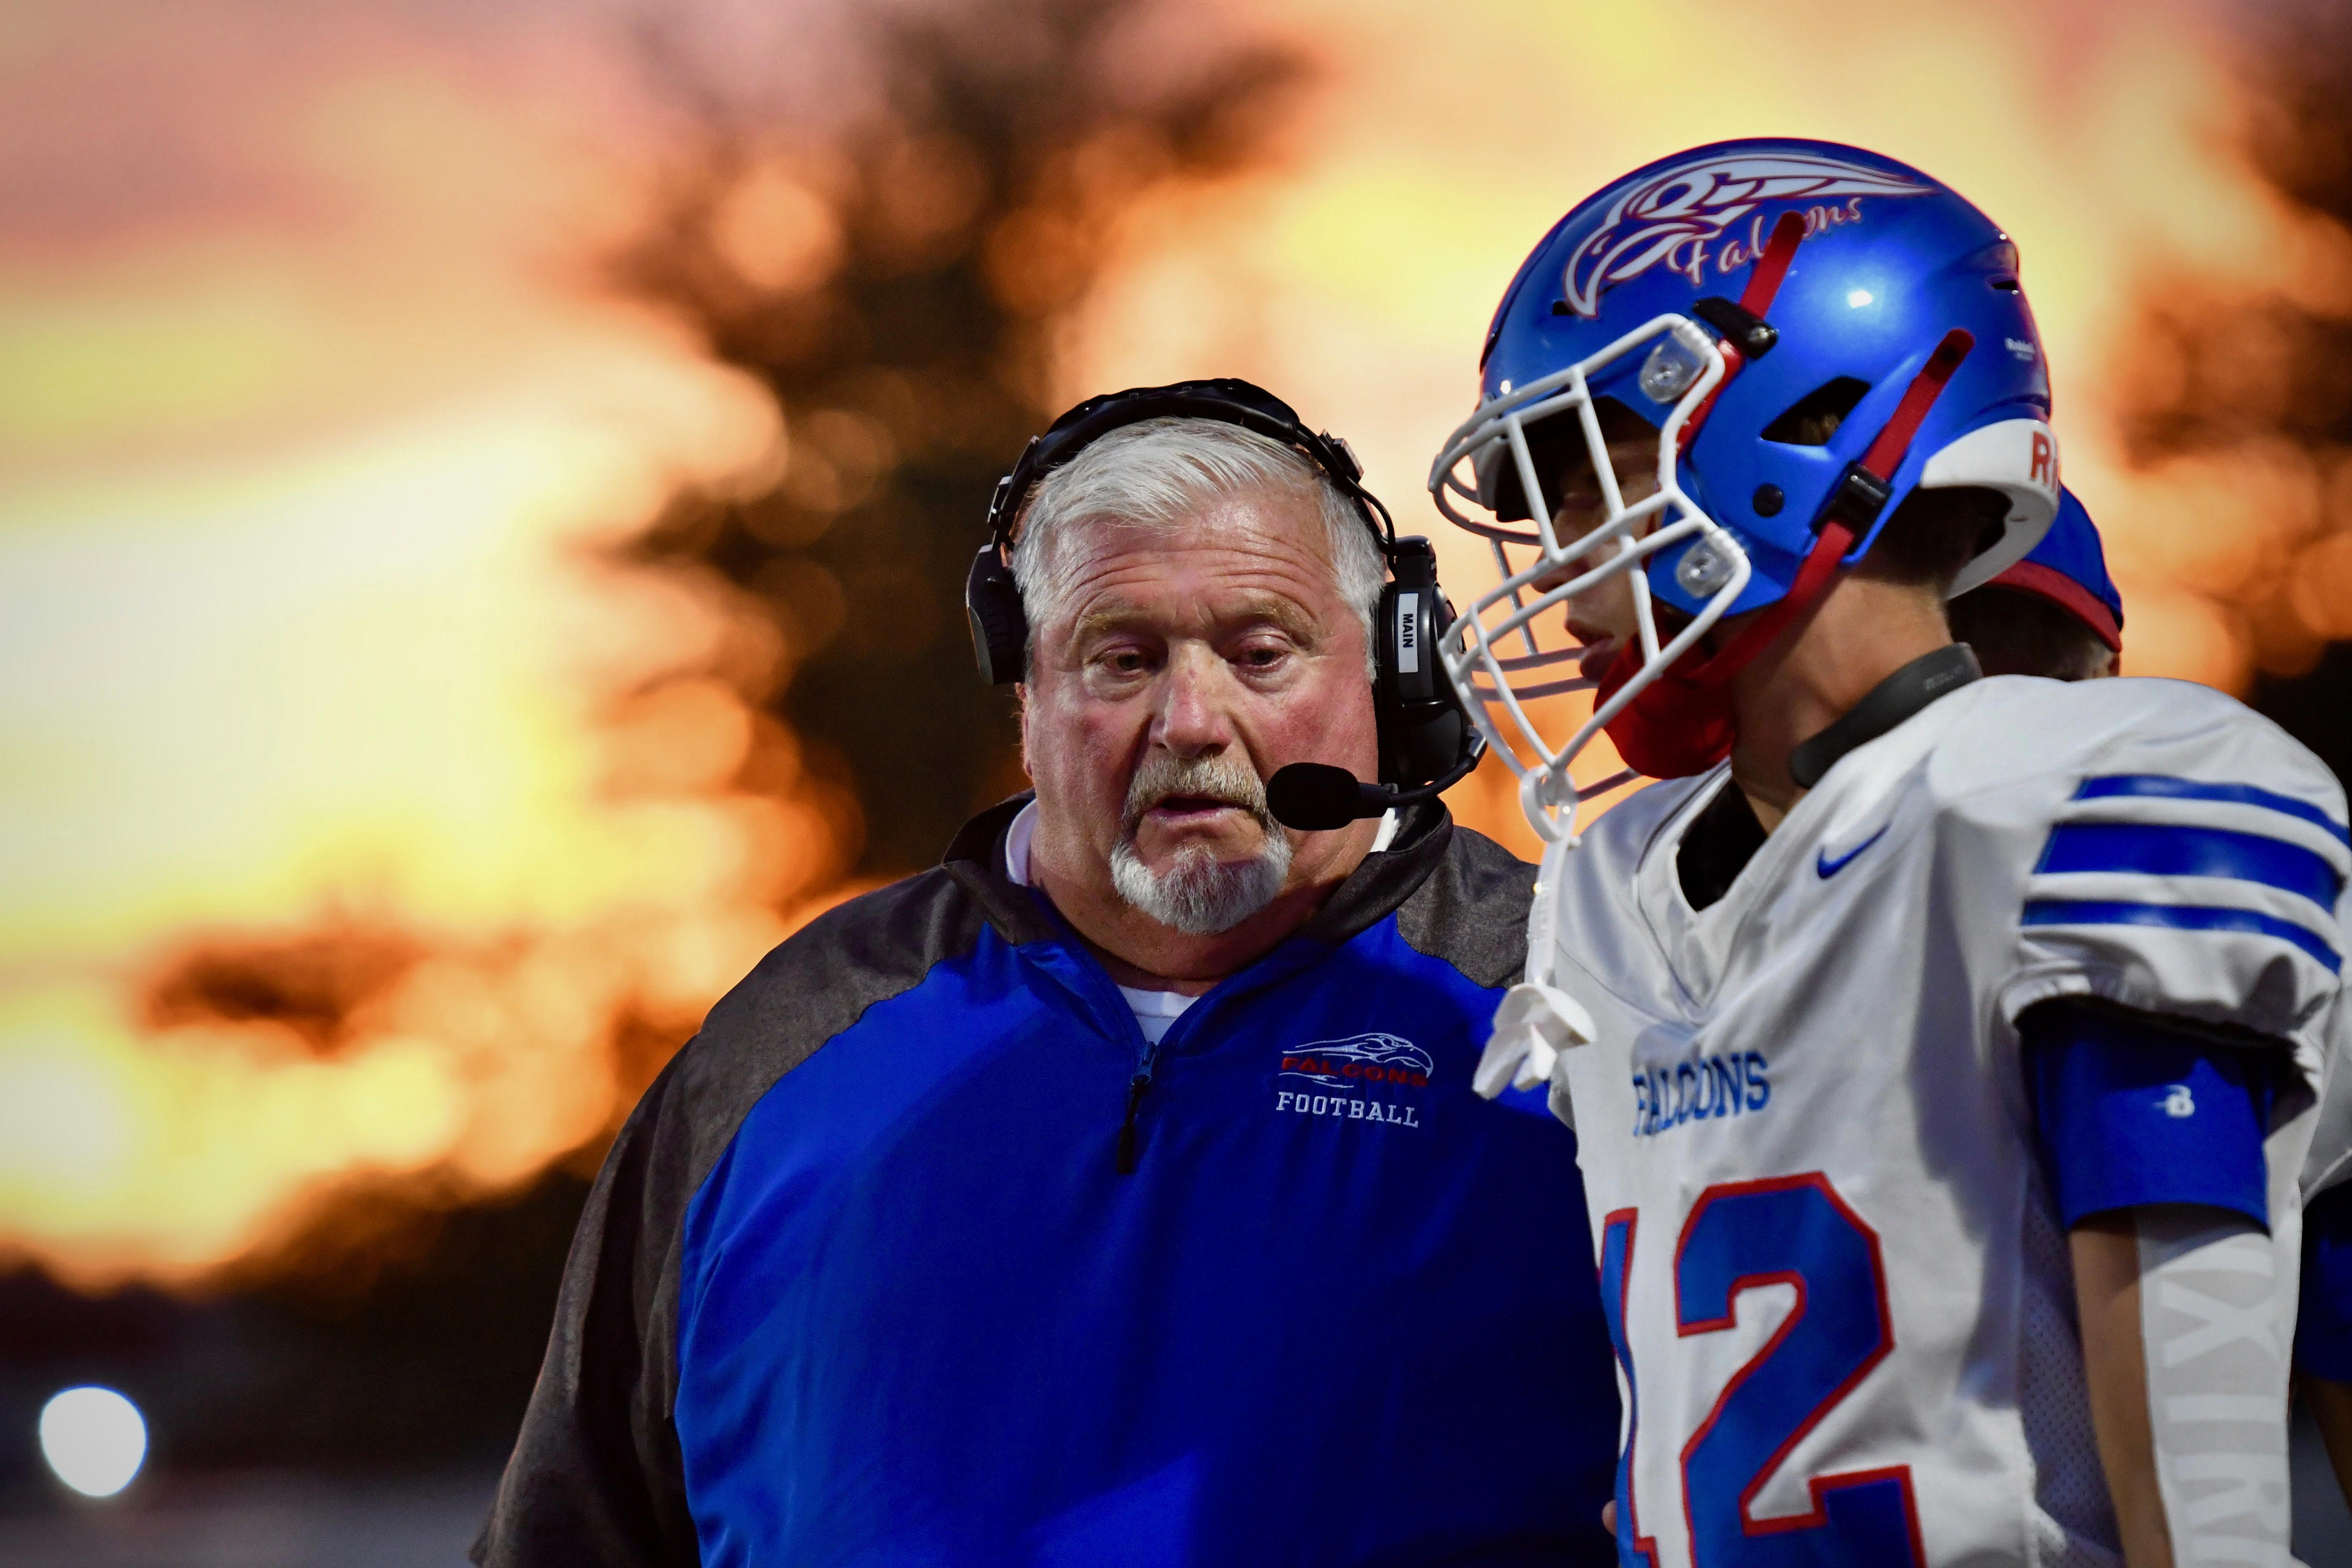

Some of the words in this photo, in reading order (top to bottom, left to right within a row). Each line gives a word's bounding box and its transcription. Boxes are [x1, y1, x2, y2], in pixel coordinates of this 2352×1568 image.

[1666, 196, 1863, 285] Falons
[1402, 613, 1414, 648] MAIN
[1281, 1056, 1429, 1088] FALCONS
[1276, 1091, 1419, 1128] FOOTBALL
[1632, 1050, 1771, 1137] FALCONS
